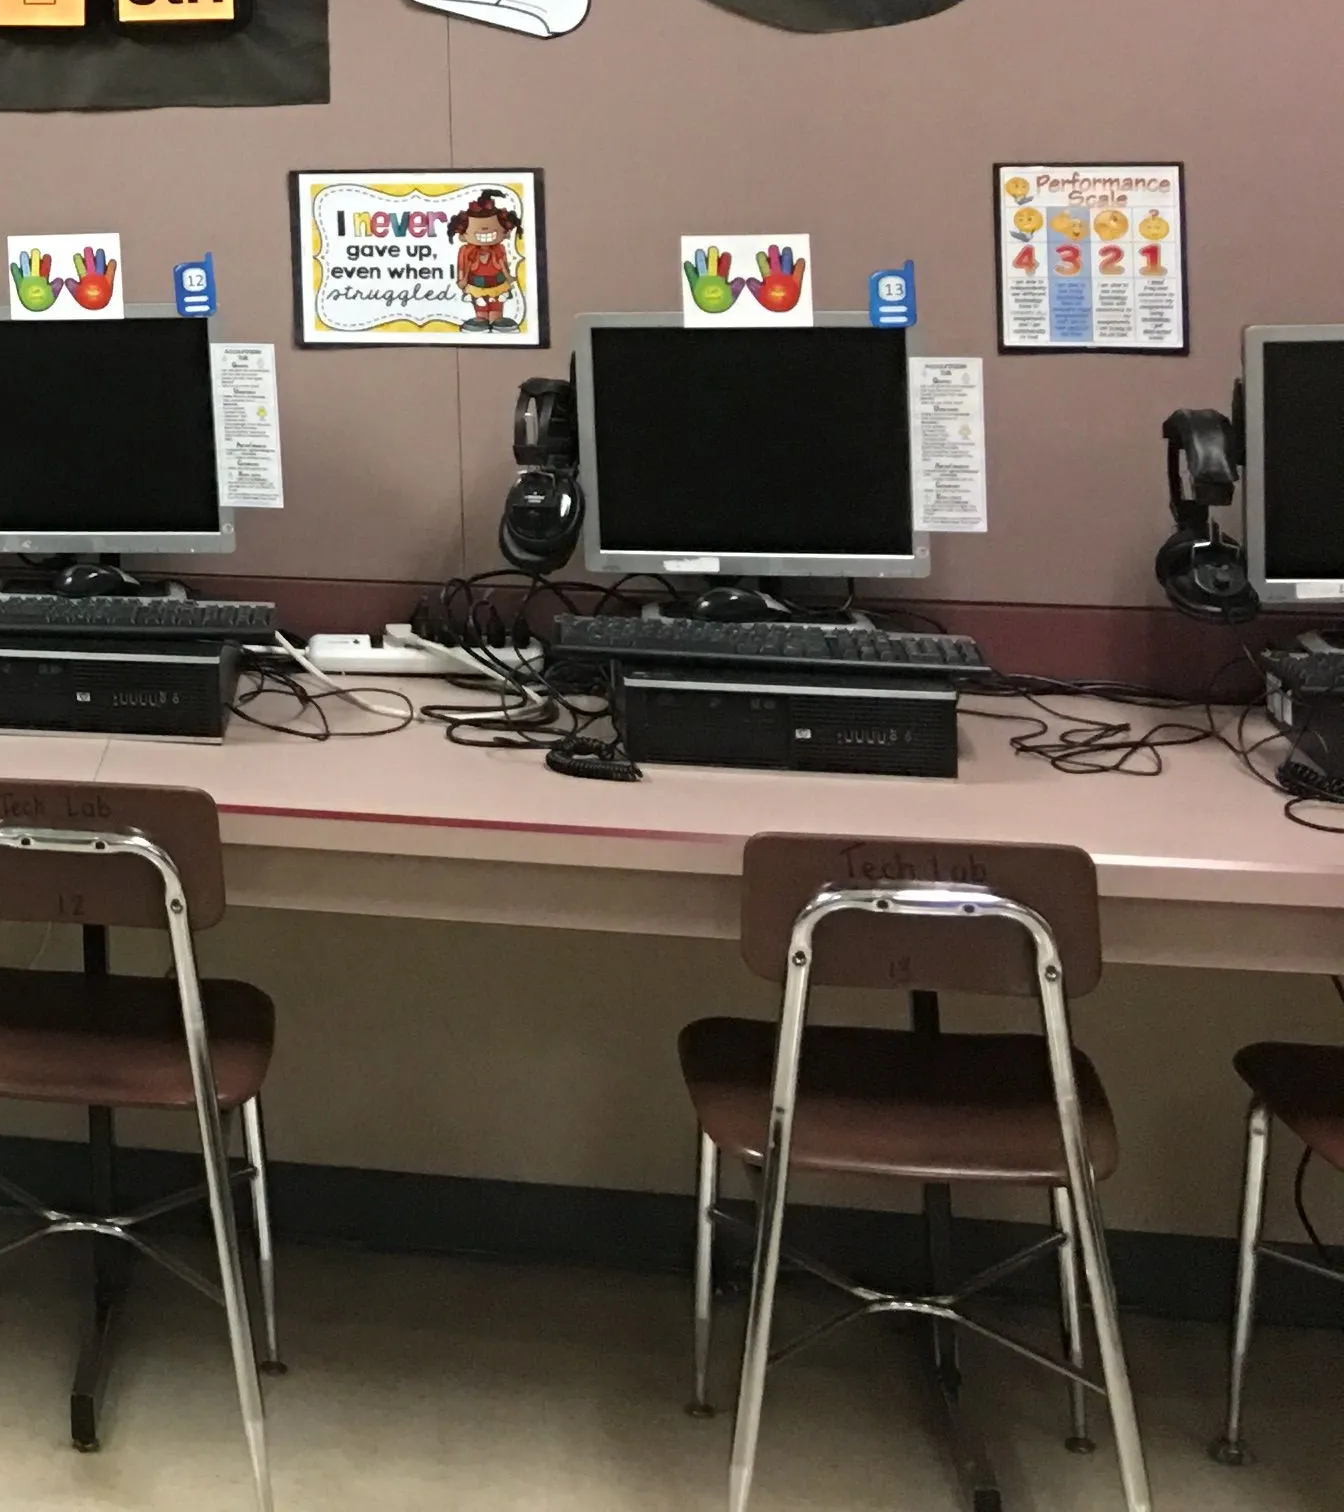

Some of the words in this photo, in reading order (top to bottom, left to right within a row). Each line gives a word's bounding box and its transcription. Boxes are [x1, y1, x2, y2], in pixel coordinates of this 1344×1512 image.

[1035, 171, 1172, 194] Performance
[1068, 190, 1129, 207] Scale
[336, 210, 346, 237] I
[352, 210, 448, 238] never
[346, 244, 401, 261] gave
[406, 244, 438, 261] up,
[1012, 244, 1039, 277] 4
[1054, 244, 1082, 277] 3
[1098, 244, 1126, 276] 2
[1138, 244, 1168, 277] 1
[186, 274, 205, 287] 12
[330, 264, 381, 280] even
[388, 263, 444, 280] when
[884, 283, 904, 296] 13
[66, 793, 112, 819] Lab
[839, 841, 916, 881] Tech
[57, 893, 84, 917] 12
